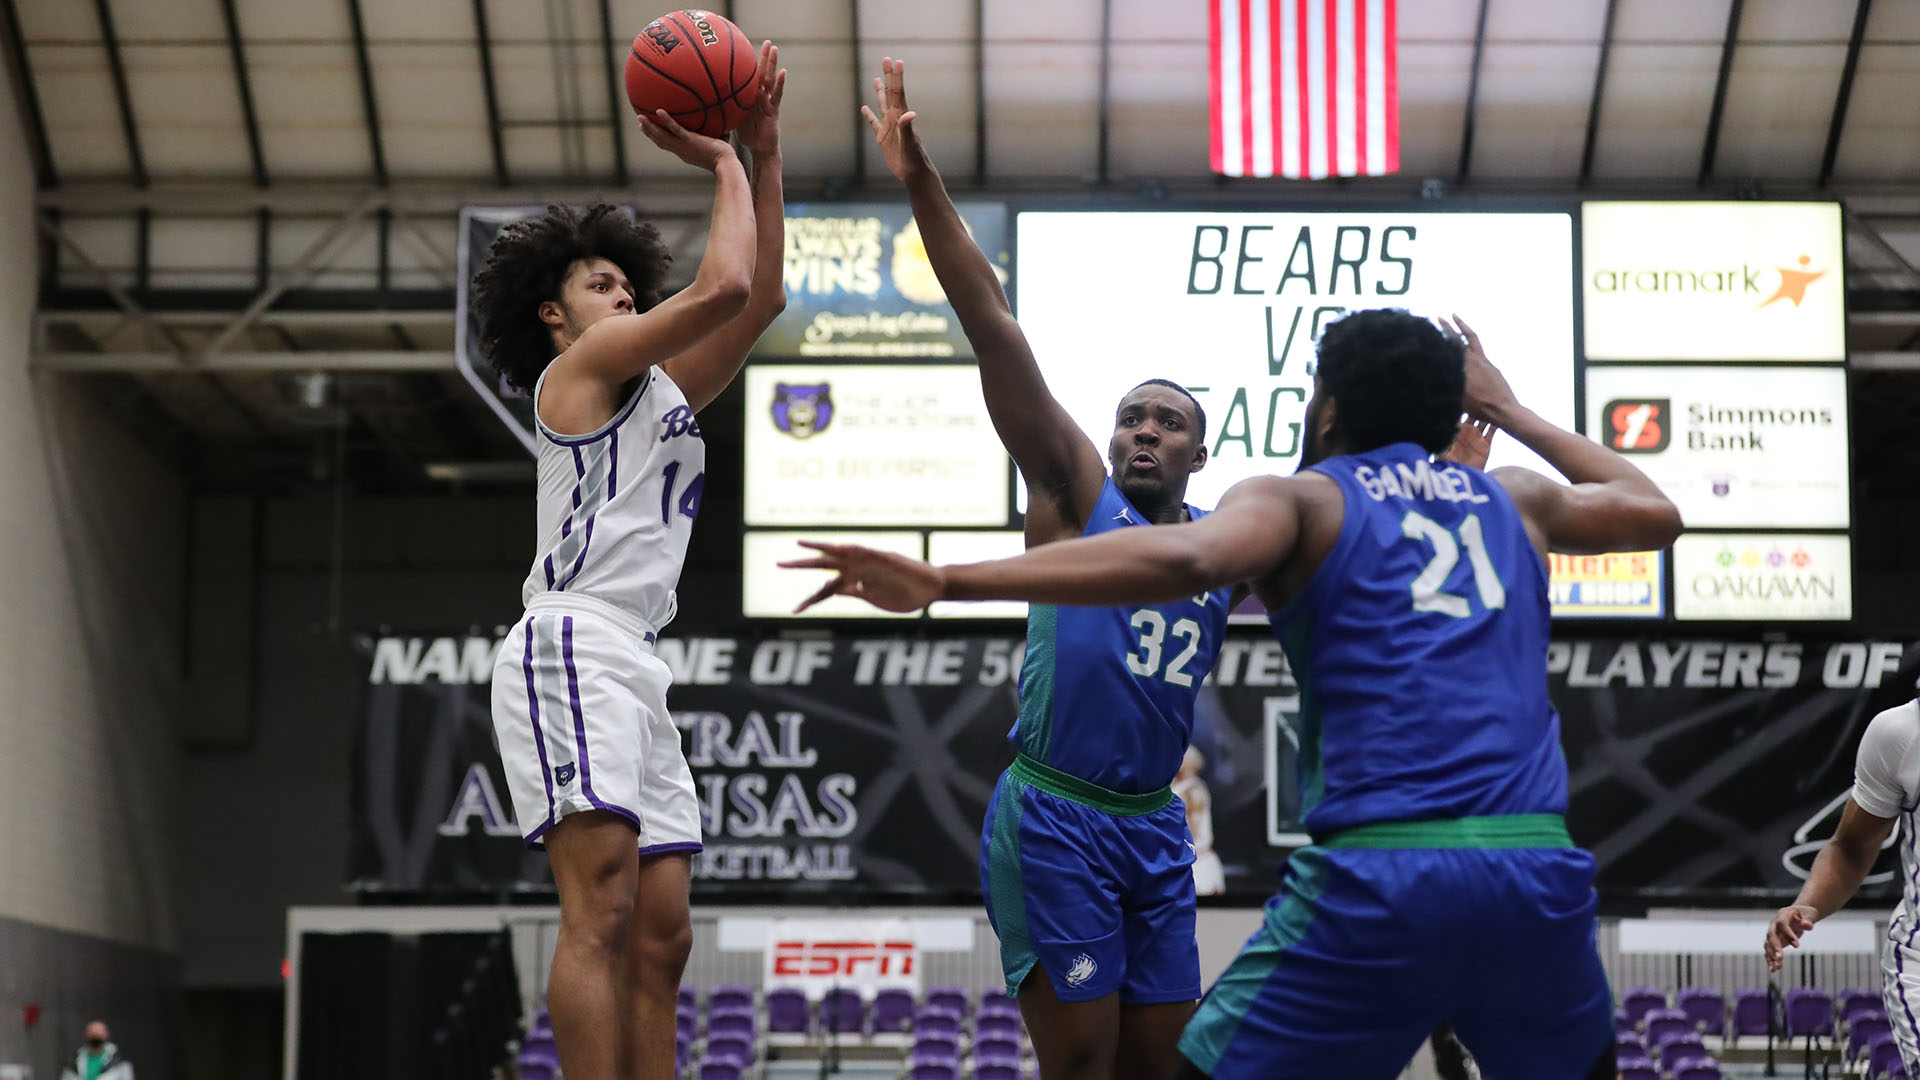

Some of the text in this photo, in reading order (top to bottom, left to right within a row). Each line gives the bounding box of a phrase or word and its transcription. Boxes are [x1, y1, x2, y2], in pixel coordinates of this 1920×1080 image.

[784, 233, 880, 260] LWAYS
[1187, 225, 1416, 295] BEARS
[1594, 264, 1760, 293] aramark
[1688, 403, 1832, 425] Simmons
[1688, 431, 1764, 451] Bank
[661, 460, 705, 529] 14
[1355, 459, 1490, 504] SAMUEL
[1401, 511, 1506, 619] 21
[1693, 574, 1835, 600] OAKLAWN
[371, 637, 502, 684] NAM
[658, 637, 737, 685] NE
[751, 638, 834, 685] OF
[852, 640, 967, 686] THE
[1547, 641, 1803, 687] PLAYERS
[1822, 642, 1904, 688] OF
[1126, 608, 1201, 688] 32
[774, 942, 914, 976] ESPN
